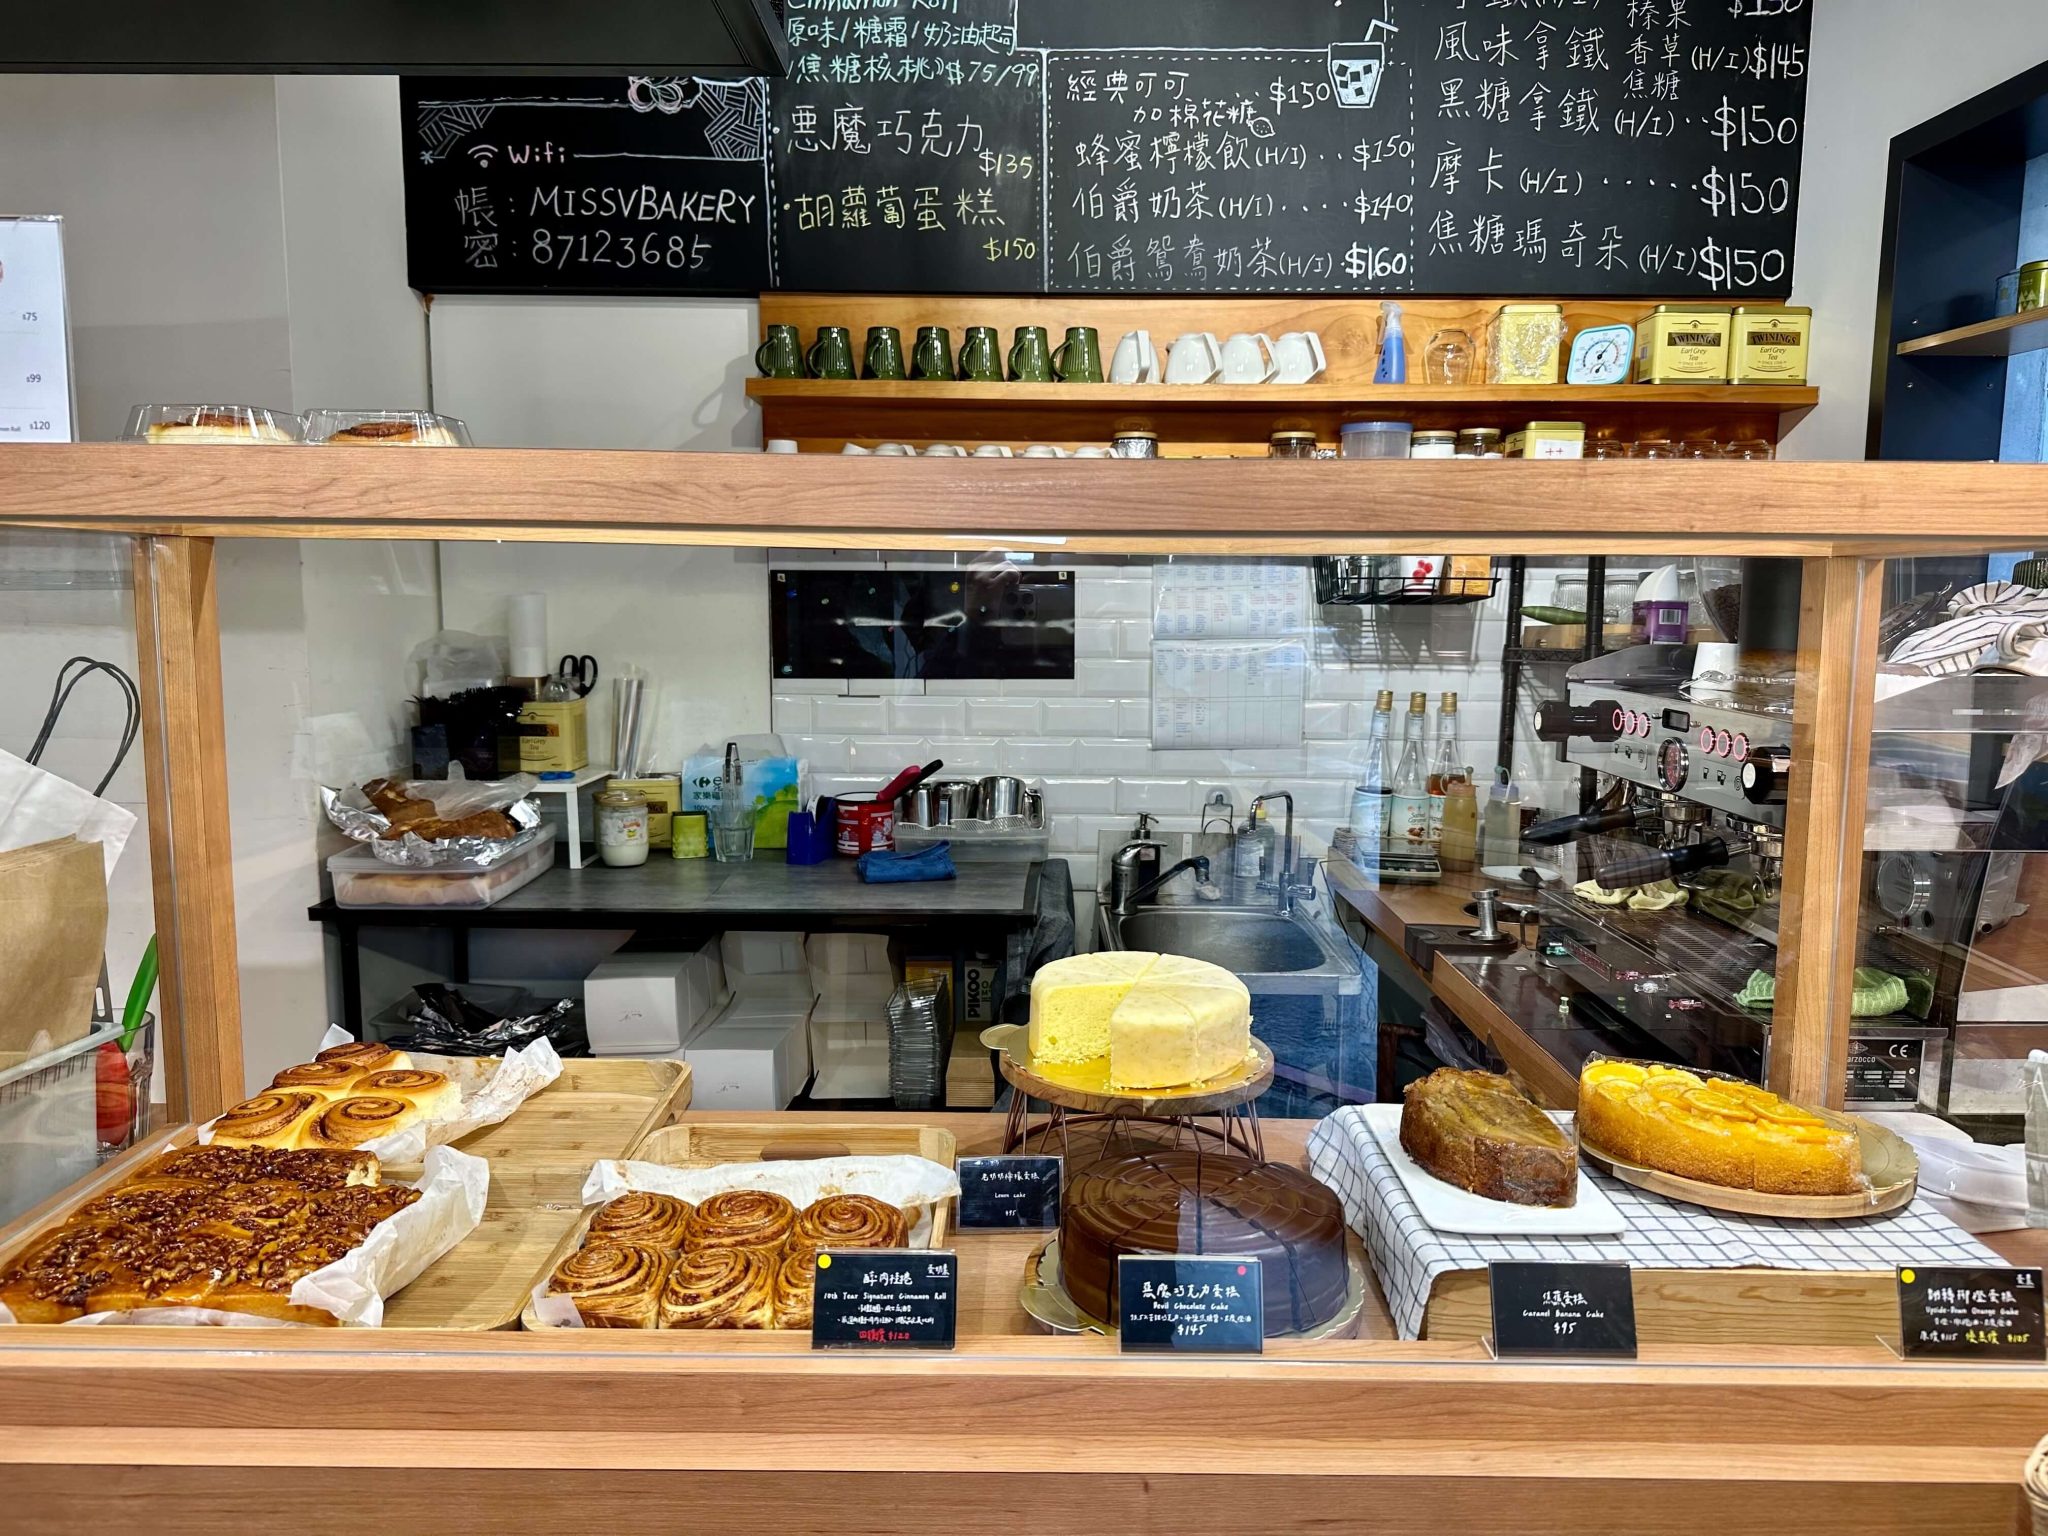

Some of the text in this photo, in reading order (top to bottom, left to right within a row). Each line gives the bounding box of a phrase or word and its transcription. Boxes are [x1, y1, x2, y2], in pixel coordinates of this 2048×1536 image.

[1434, 20, 1610, 70] 風味拿鐵
[1625, 33, 1681, 67] 香草
[1748, 41, 1805, 80] $145
[1066, 69, 1331, 115] 經典可可 $150
[1622, 68, 1681, 101] 焦糖
[1133, 98, 1257, 129] 加棉花糖
[1437, 77, 1601, 136] 黑糖拿鐵
[1710, 95, 1798, 152] $150
[507, 142, 566, 165] Wifi
[979, 148, 1033, 178] $135
[1353, 134, 1412, 171] $150
[530, 184, 756, 224] MISSVBAKERY
[1354, 189, 1412, 224] $140
[1700, 165, 1789, 217] $150
[794, 185, 1006, 232] 胡蘿蔔蛋糕
[531, 229, 712, 270] 87123685
[982, 237, 1036, 263] $150
[1344, 242, 1407, 281] $160
[1698, 236, 1785, 291] $150
[1672, 334, 1719, 345] TWININGS
[1693, 347, 1707, 355] Grey
[1751, 333, 1797, 345] TWININGS
[1760, 346, 1786, 355] Earl Grey
[863, 1292, 894, 1303] Signature
[934, 1292, 947, 1300] Roll
[1153, 1302, 1229, 1310] Devil Chocolate Cake
[1177, 1324, 1207, 1336] $145
[1522, 1310, 1604, 1318] Caramel Banana Cake
